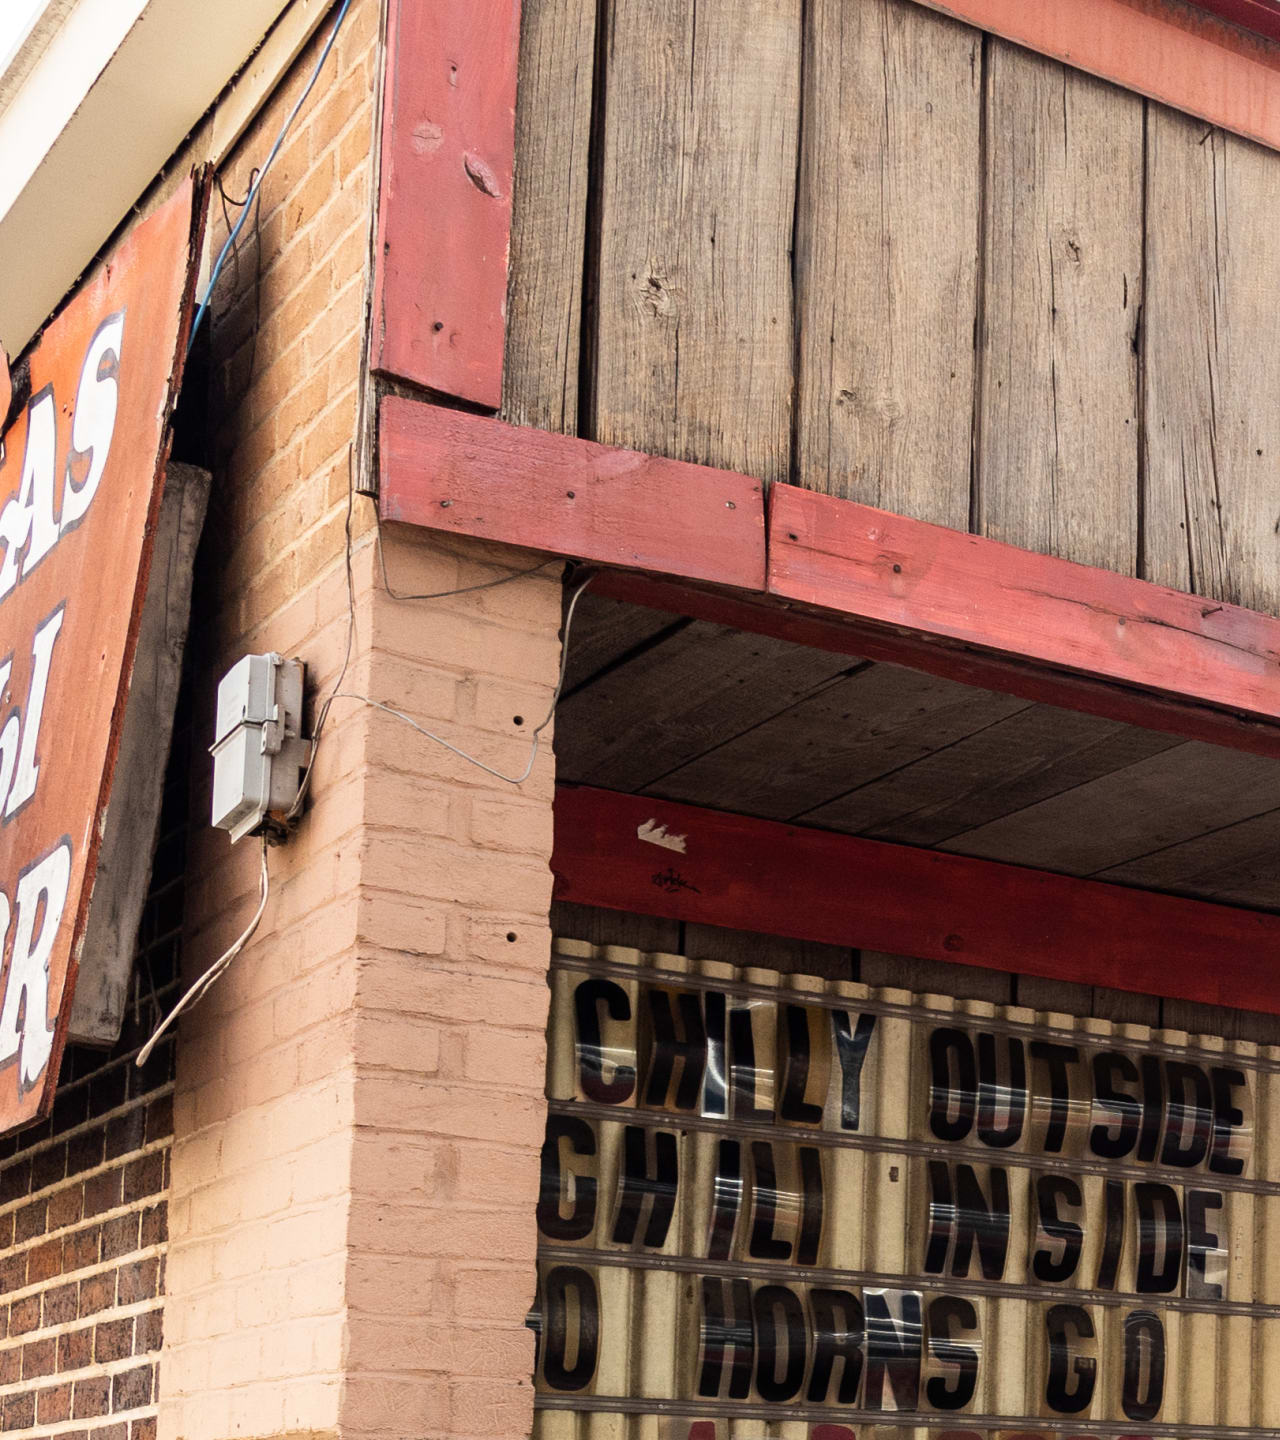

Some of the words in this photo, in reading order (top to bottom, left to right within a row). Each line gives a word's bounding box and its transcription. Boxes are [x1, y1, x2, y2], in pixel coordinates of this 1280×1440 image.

[0, 304, 127, 604] AS
[574, 978, 876, 1132] CHILLY
[928, 1026, 1249, 1176] OUTSIDE
[923, 1160, 1226, 1302] INSIDE
[526, 1264, 600, 1392] O
[697, 1275, 985, 1413] HORNS
[1046, 1303, 1167, 1423] GO
